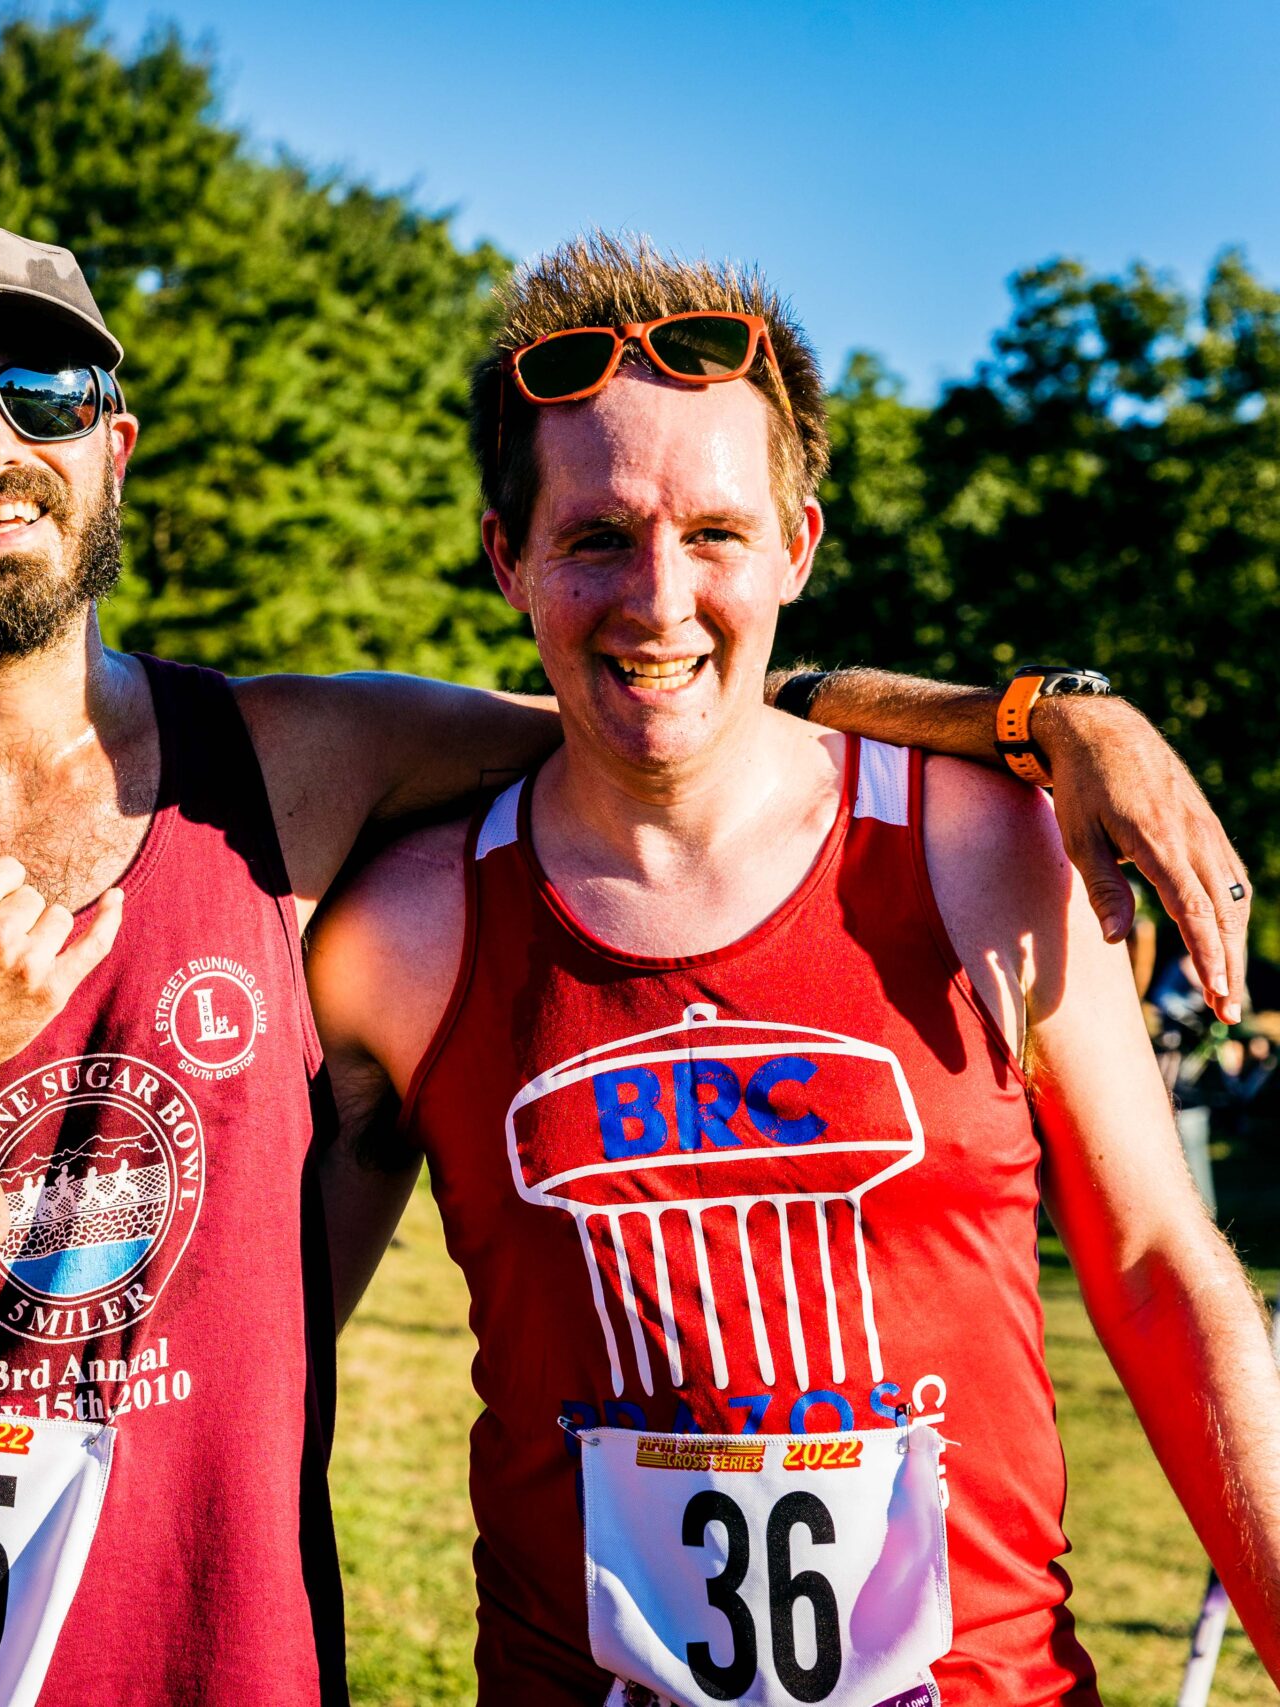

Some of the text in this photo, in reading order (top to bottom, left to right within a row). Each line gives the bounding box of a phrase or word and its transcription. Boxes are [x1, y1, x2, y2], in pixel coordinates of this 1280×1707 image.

[155, 967, 188, 1032] STREET
[187, 955, 256, 990] RUNNING
[253, 989, 268, 1035] CLUB
[177, 1049, 257, 1081] SOUTH BOSTON
[591, 1054, 830, 1161] BRC
[41, 1061, 160, 1106] SUGAR
[156, 1095, 200, 1211] BOWL
[7, 1282, 156, 1337] 5 MILER
[114, 1369, 192, 1417] 2010
[666, 1453, 763, 1473] CROSS SERIES
[783, 1439, 864, 1471] 2022
[681, 1489, 843, 1704] 36
